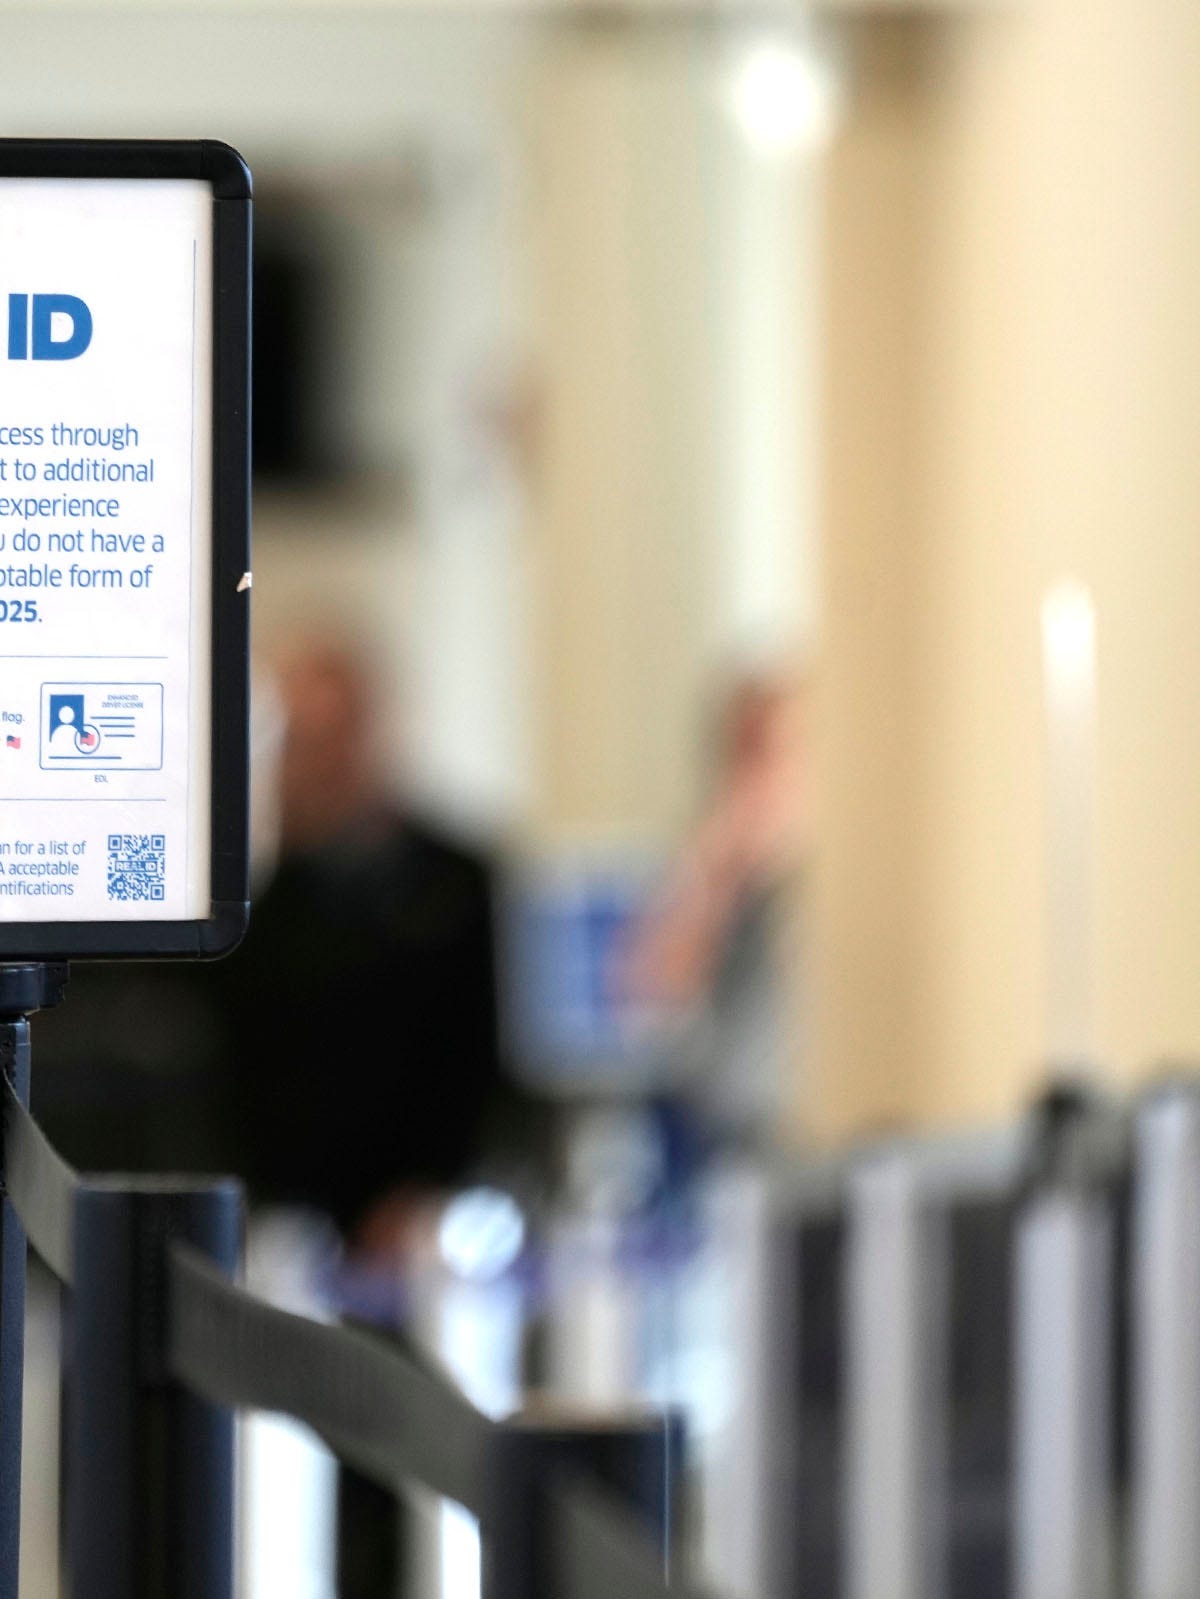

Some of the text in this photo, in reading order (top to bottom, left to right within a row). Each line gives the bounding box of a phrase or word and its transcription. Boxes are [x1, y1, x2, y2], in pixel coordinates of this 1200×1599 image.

[8, 293, 93, 361] ID
[51, 422, 138, 451] through
[14, 459, 36, 481] to
[44, 458, 153, 482] additional
[13, 528, 40, 552] do
[48, 530, 84, 552] not
[92, 529, 145, 553] have
[152, 535, 164, 552] a
[69, 564, 122, 587] form
[130, 565, 153, 588] of
[2, 711, 24, 724] flag.
[15, 840, 34, 855] for
[38, 843, 45, 855] a
[50, 841, 68, 855] list
[72, 840, 87, 855] of
[8, 861, 79, 877] acceptable
